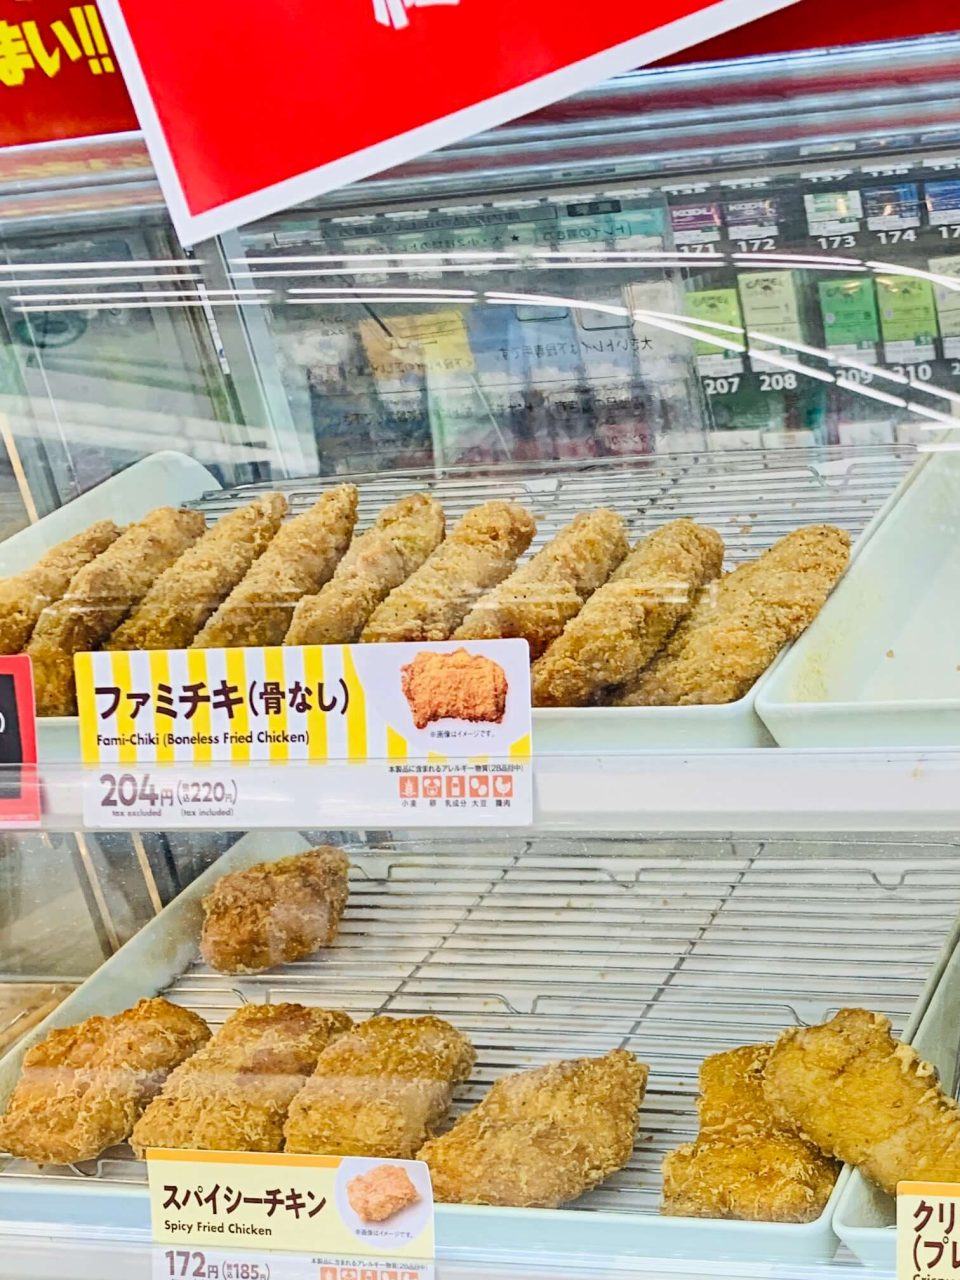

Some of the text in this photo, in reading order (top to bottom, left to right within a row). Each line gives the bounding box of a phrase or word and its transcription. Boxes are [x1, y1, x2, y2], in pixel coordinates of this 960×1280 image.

[737, 238, 776, 252] 172
[817, 235, 856, 250] 173
[877, 230, 917, 245] 174
[705, 378, 740, 395] 207
[759, 374, 798, 392] 208
[95, 678, 350, 720] ファミチキ(骨なし)
[97, 730, 310, 747] Fami-Chiki (Boneless Fried Chicken)
[162, 1183, 327, 1220] スパイシーチキン
[164, 1220, 272, 1237] Spicy Fried Chicken
[165, 1250, 219, 1280] 172円
